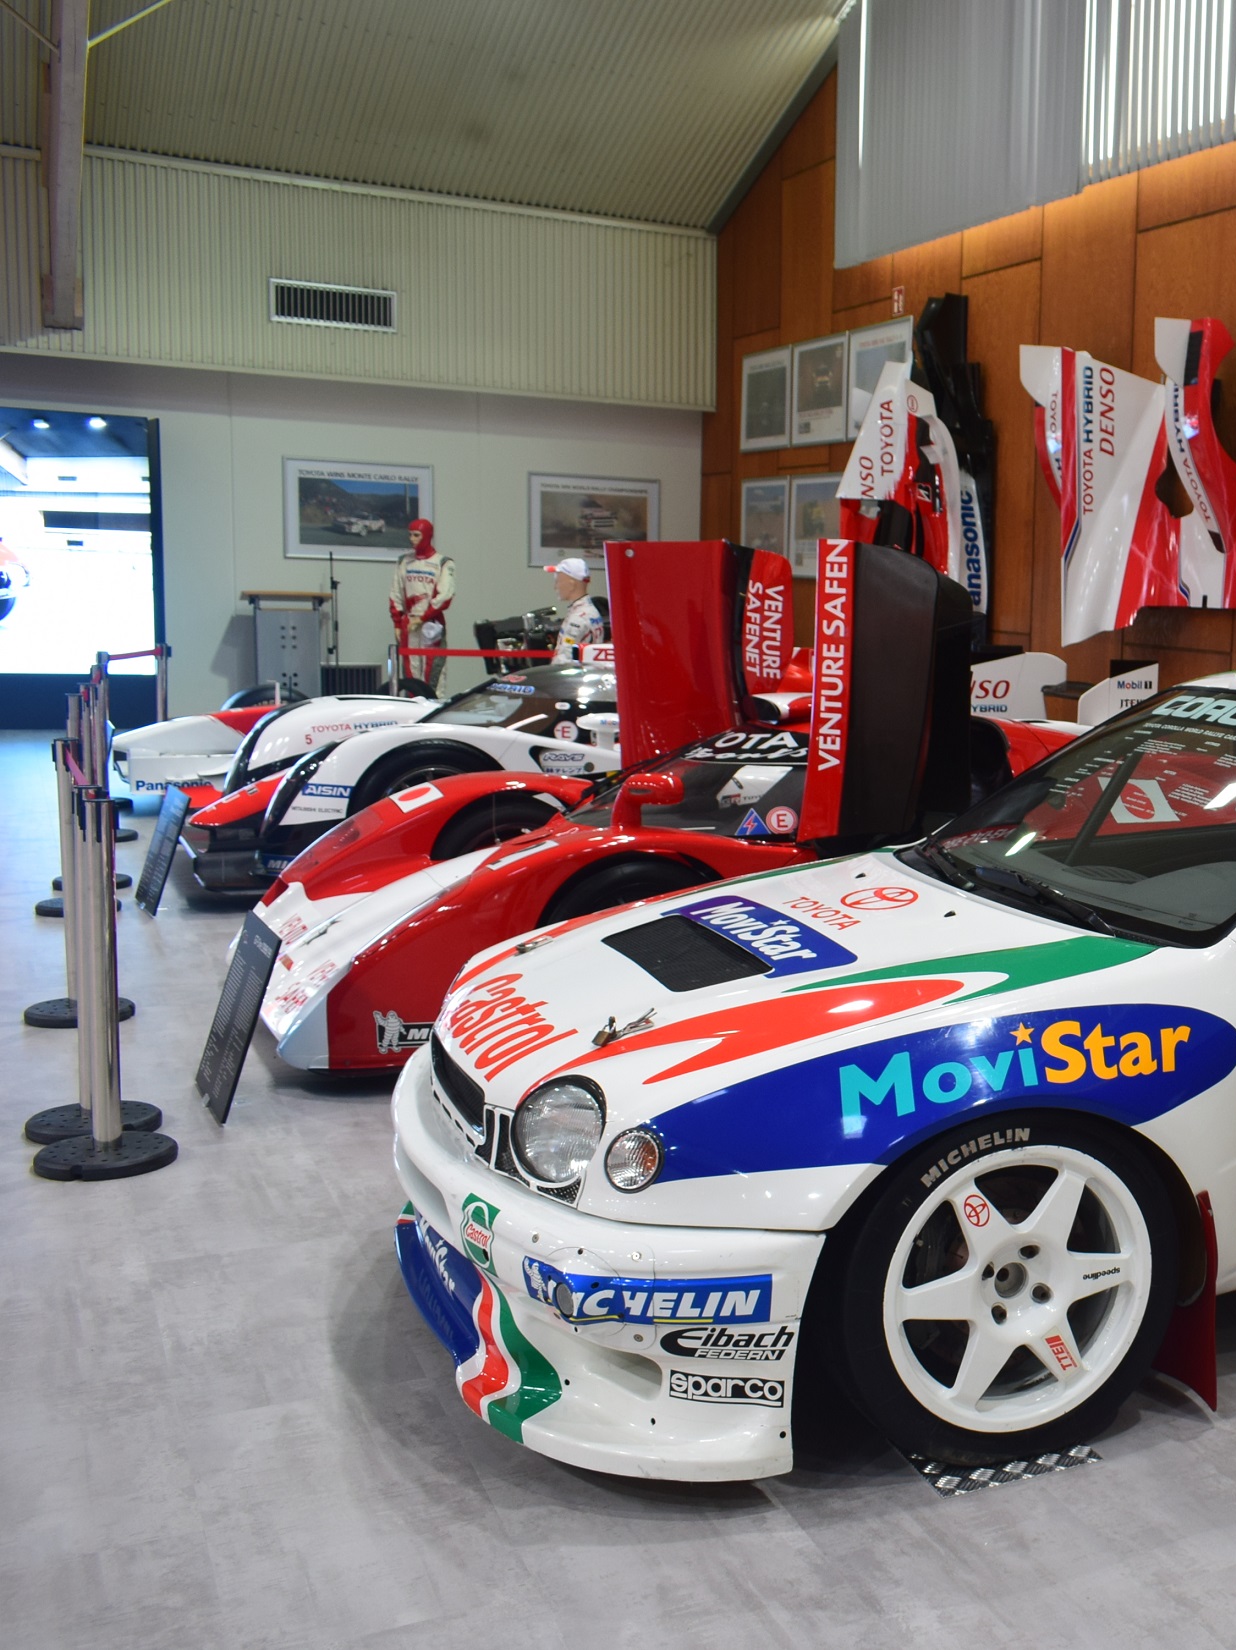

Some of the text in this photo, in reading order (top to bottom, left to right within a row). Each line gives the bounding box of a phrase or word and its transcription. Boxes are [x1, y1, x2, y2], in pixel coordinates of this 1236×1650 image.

[1100, 368, 1115, 457] DENSO
[880, 399, 894, 477] TOYOTA
[1083, 366, 1094, 515] TOYOTA HYBRID
[745, 580, 764, 678] SAFENET
[763, 585, 784, 680] VENTURE
[1117, 680, 1143, 690] Mobil
[817, 644, 845, 771] VENTURE
[305, 734, 313, 745] 5
[311, 723, 352, 733] TOYOTA
[714, 731, 799, 750] OTA
[1161, 724, 1185, 732] COROLLA
[1184, 727, 1205, 735] WORLD
[1203, 728, 1225, 738] RALLYE
[543, 753, 585, 762] RAYS
[304, 784, 351, 797] AISIN
[776, 813, 788, 828] E
[782, 896, 863, 931] TOYOTA
[690, 901, 818, 962] MoviStar
[448, 973, 579, 1083] Castrol
[839, 1020, 1192, 1139] MoviStar
[920, 1127, 1031, 1188] MICHELIN
[465, 1223, 491, 1248] Castrol
[1082, 1267, 1121, 1281] speedline
[660, 1326, 795, 1357] Eibach
[694, 1349, 784, 1361] FEDERN
[670, 1373, 784, 1404] sparco
